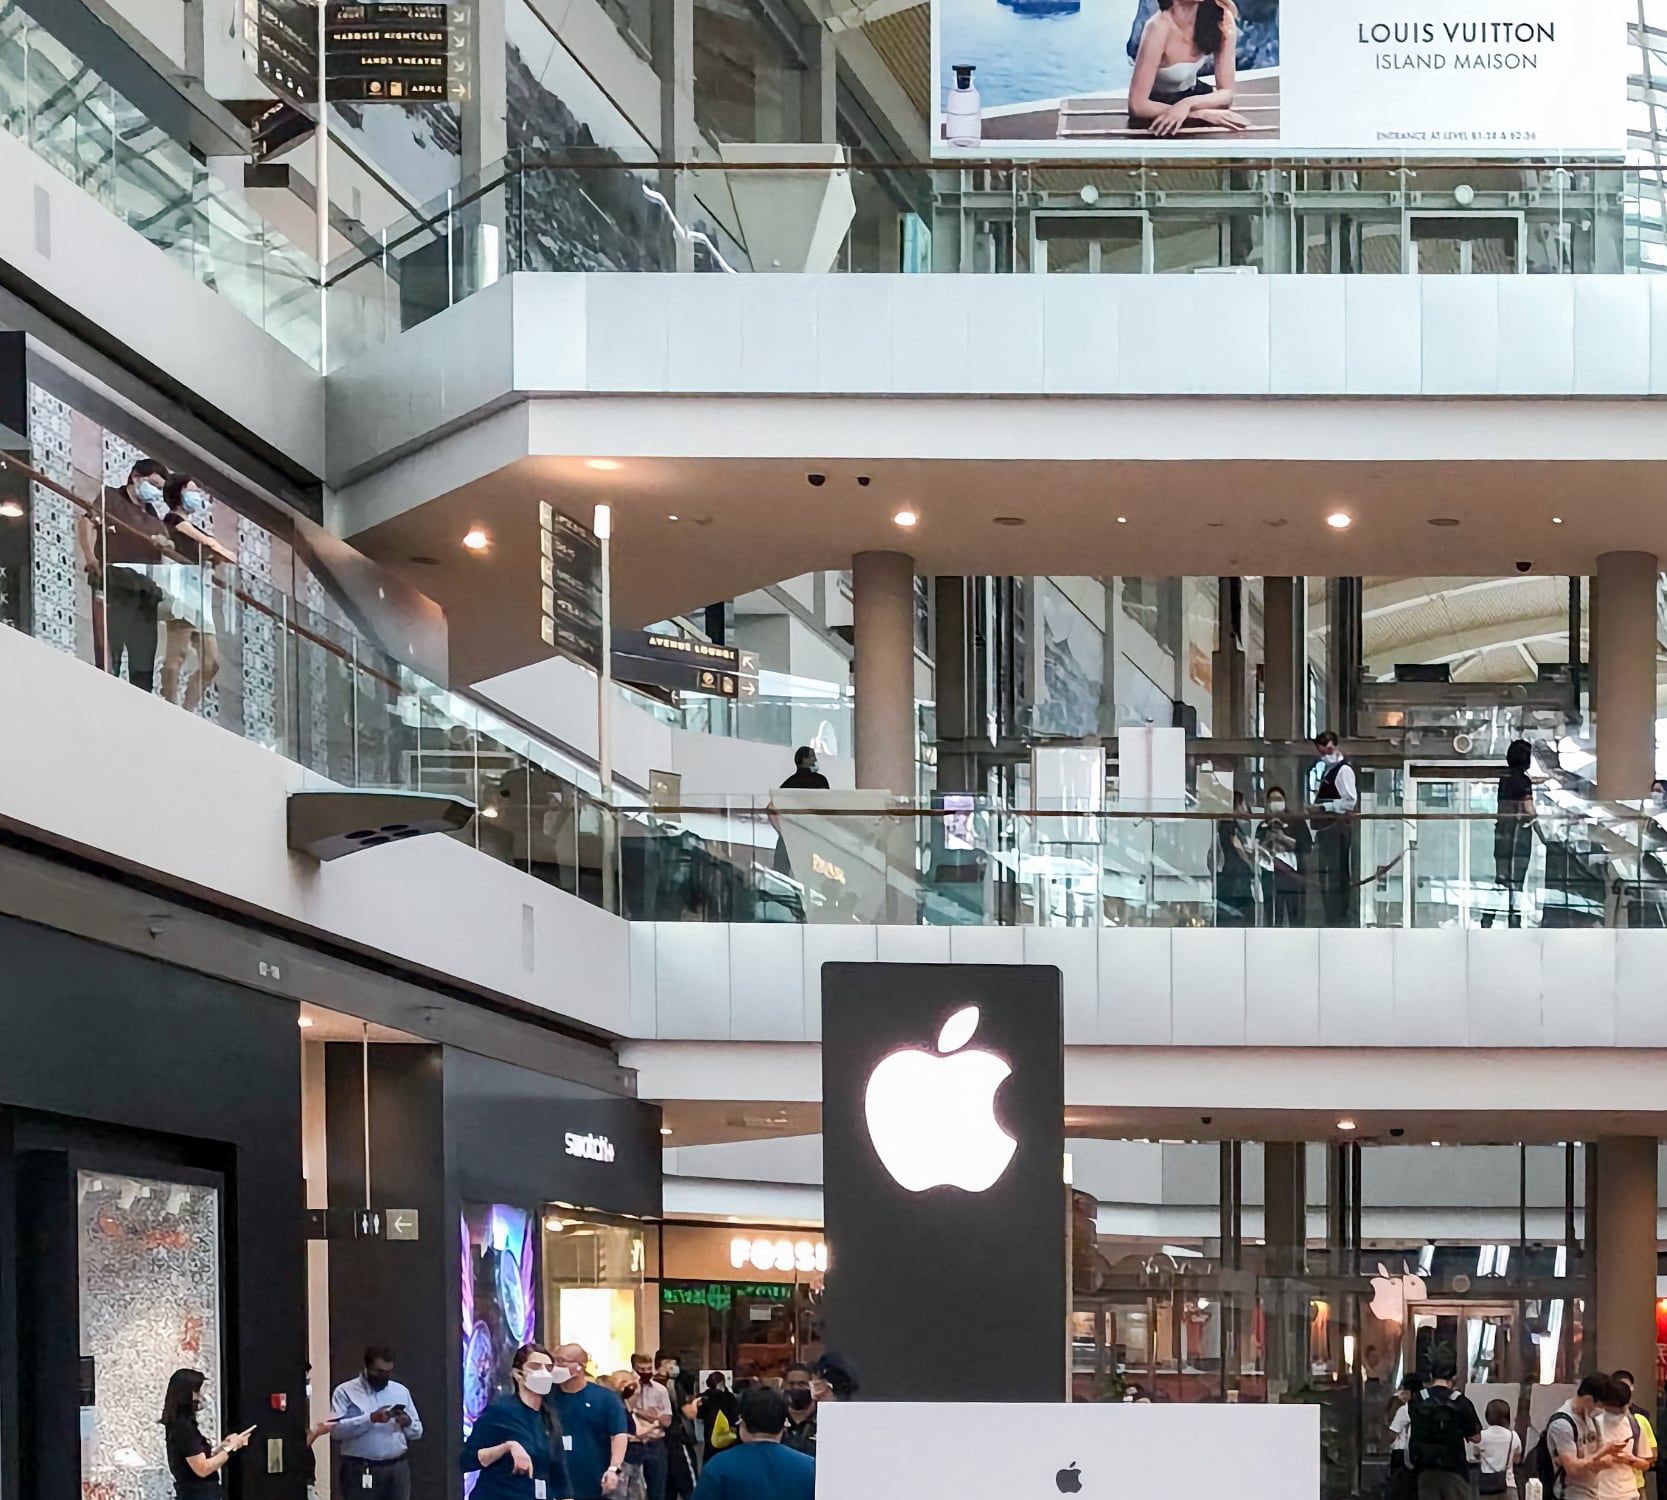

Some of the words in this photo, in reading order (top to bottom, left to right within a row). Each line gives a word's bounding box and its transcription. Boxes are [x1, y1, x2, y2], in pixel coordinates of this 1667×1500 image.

[1358, 22, 1434, 44] LOUIS
[1443, 22, 1555, 43] VUITTON
[1376, 53, 1446, 70] ISLAND
[1454, 53, 1537, 70] MAISON
[411, 84, 442, 93] APPLE
[649, 636, 691, 652] AVENUE
[694, 645, 735, 659] LOUNGE
[730, 1238, 828, 1272] FOSSI
